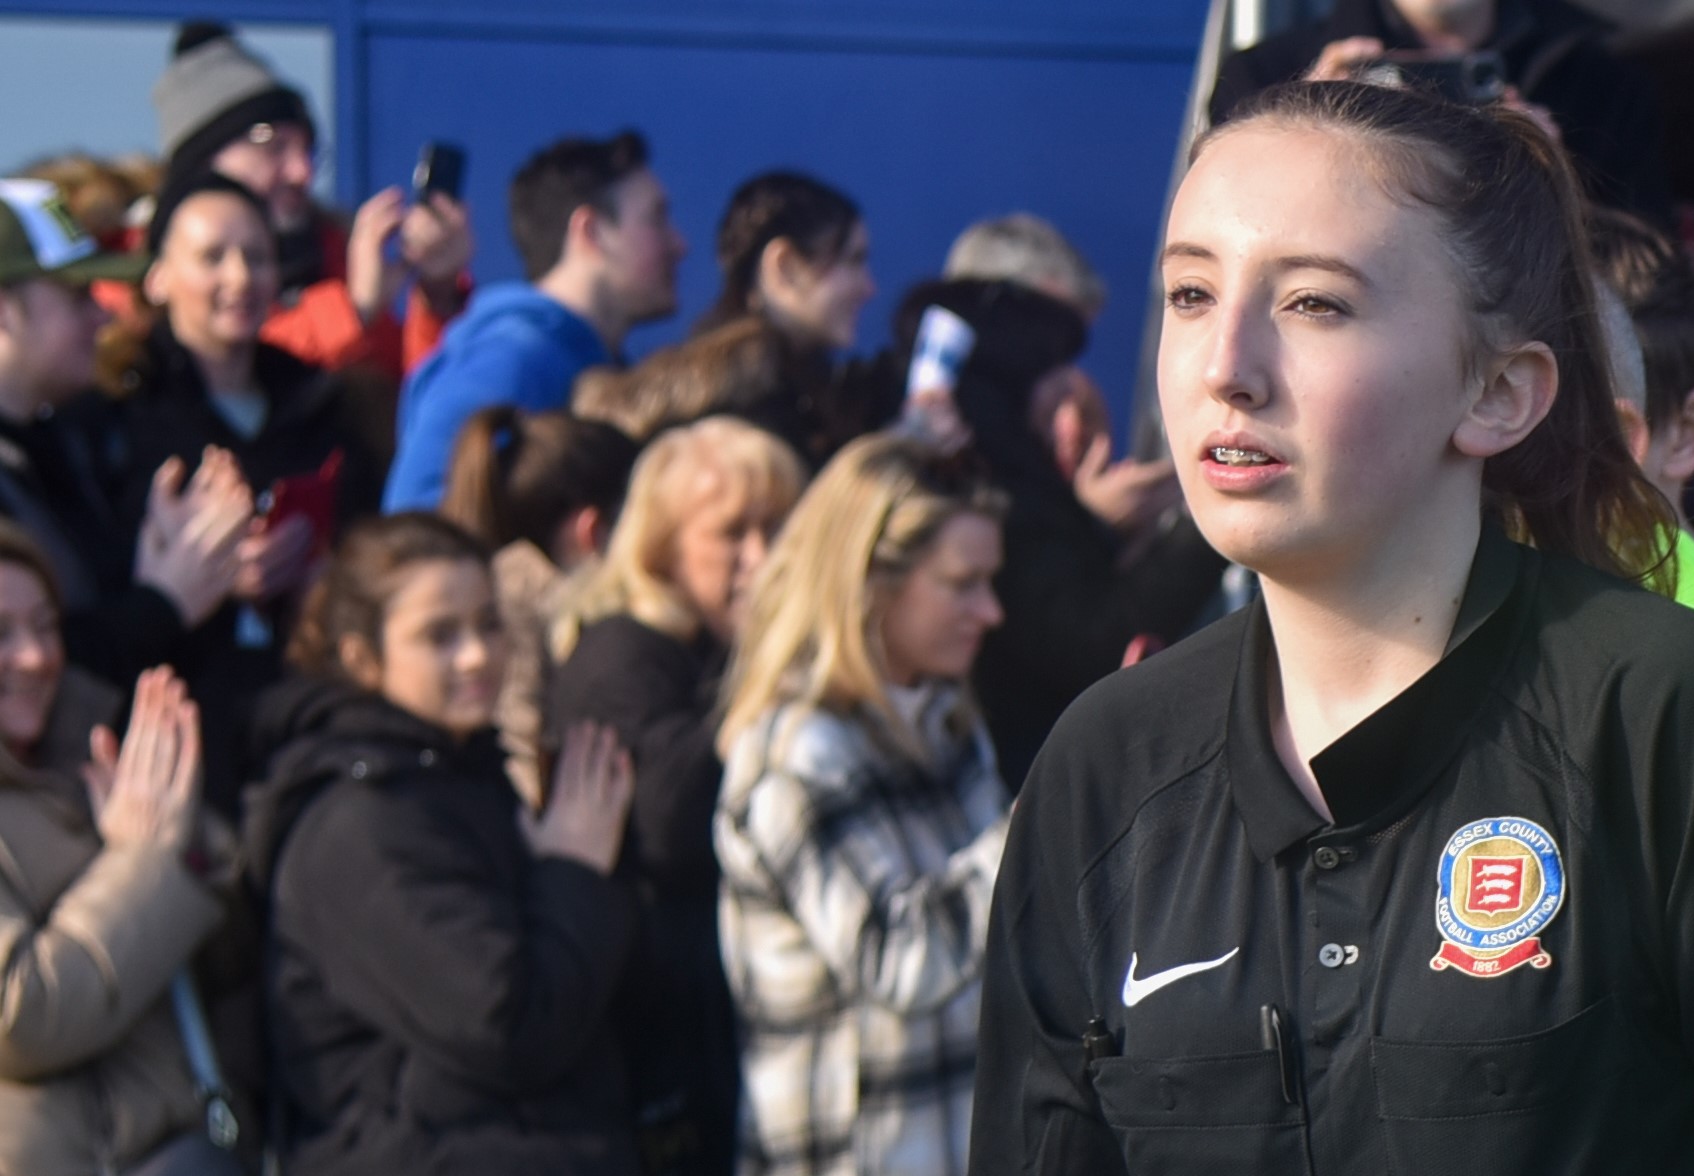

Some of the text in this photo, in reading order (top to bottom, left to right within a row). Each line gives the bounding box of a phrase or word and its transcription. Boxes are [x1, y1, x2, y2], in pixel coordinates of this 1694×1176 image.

[1447, 821, 1554, 857] ESSEX COUNTY
[1438, 894, 1558, 946] FOOTBALL ASSOCIATION
[1472, 959, 1502, 973] 1882
